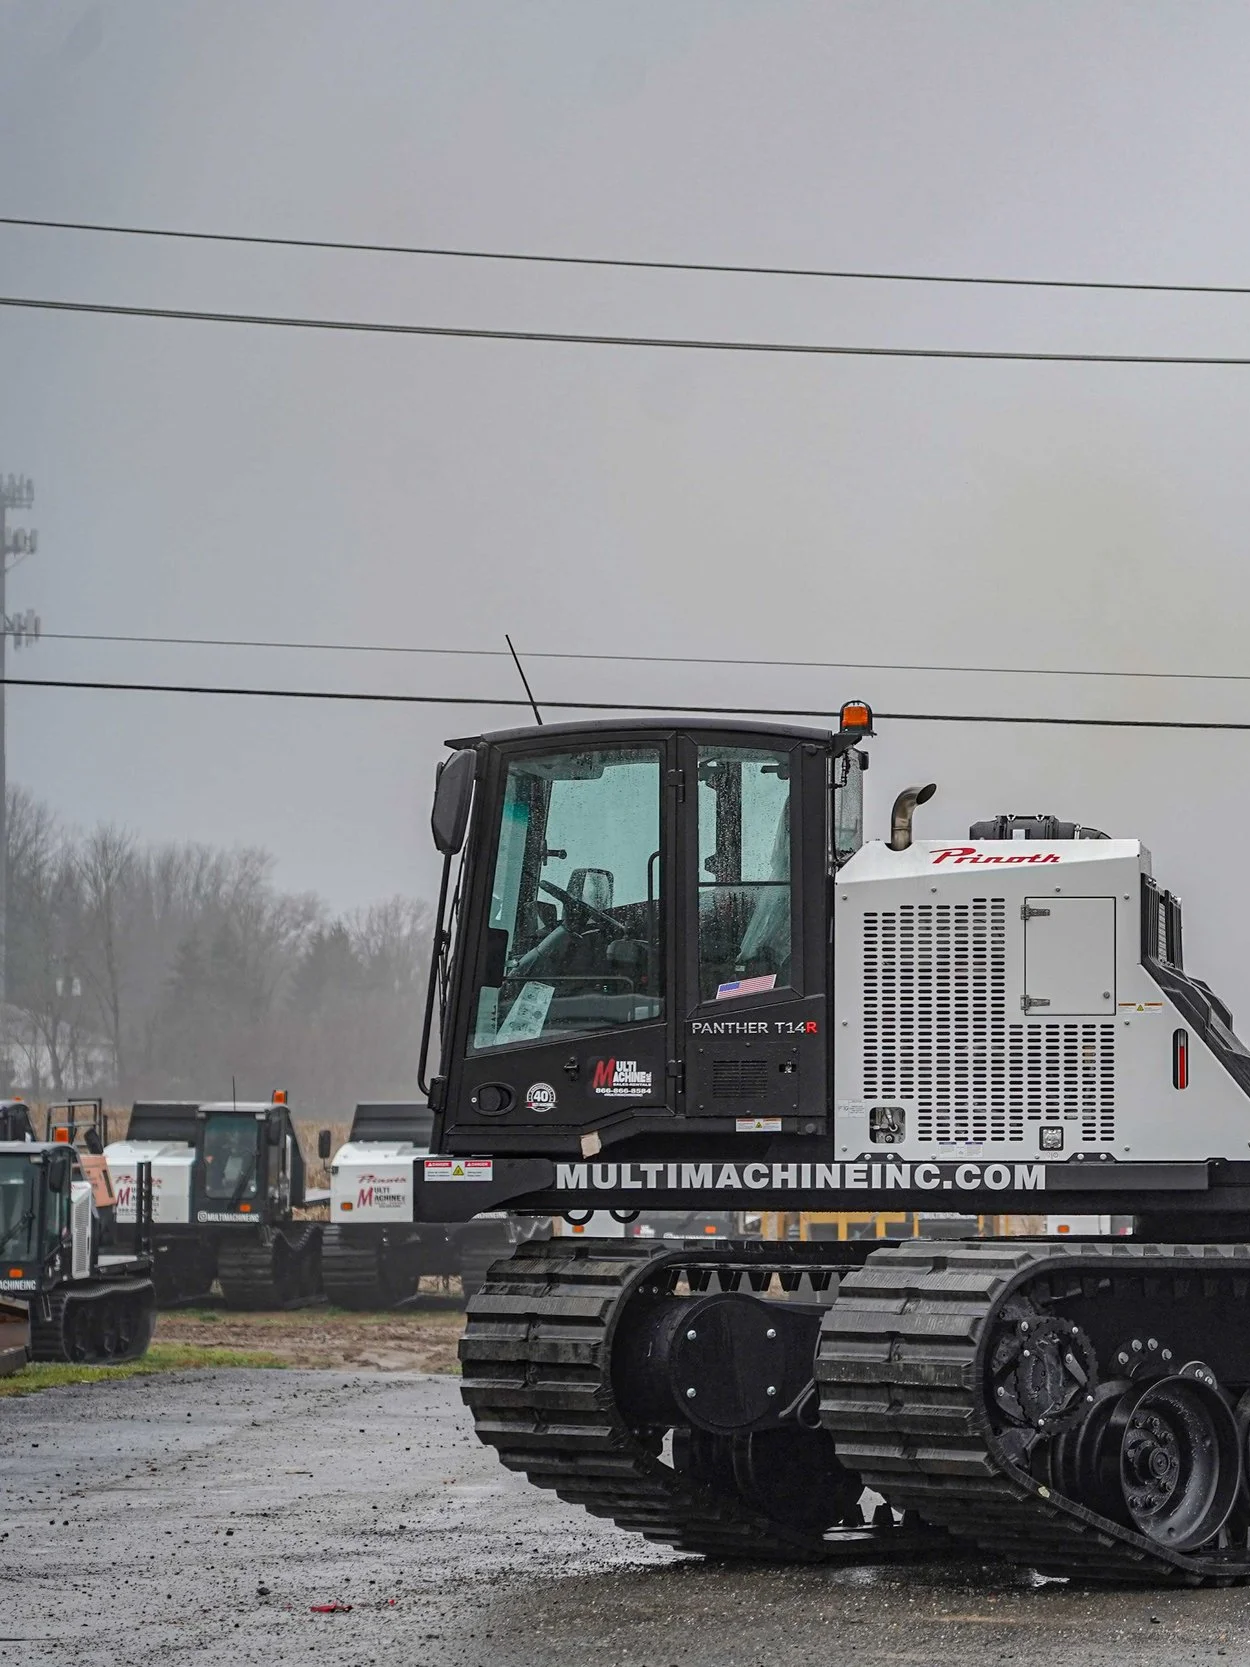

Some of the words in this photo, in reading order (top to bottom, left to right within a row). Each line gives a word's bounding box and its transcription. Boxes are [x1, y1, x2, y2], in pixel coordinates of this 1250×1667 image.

[929, 847, 1060, 864] Prinoth
[692, 1022, 768, 1034] PANTHER
[775, 1021, 817, 1034] T14R
[533, 1090, 549, 1102] 40
[556, 1163, 1046, 1190] MULTIMACHINEINC.COM
